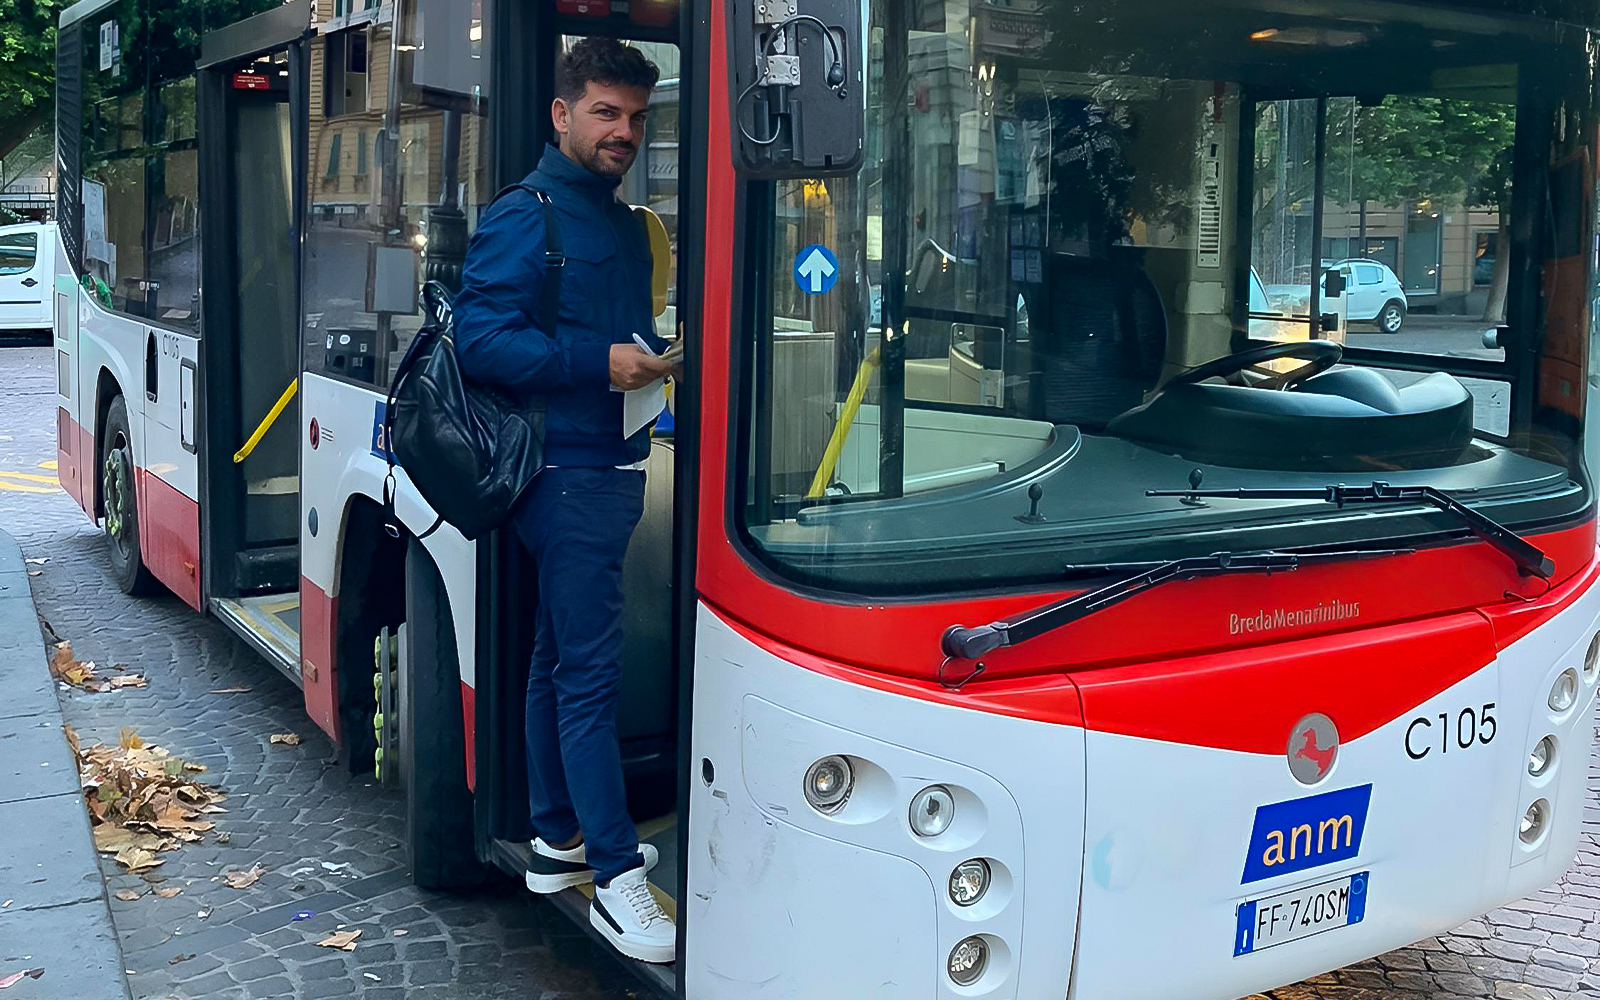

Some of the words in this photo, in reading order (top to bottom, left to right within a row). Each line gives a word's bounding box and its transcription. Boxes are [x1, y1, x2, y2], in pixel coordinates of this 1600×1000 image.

[1229, 598, 1360, 635] BredaMenarinibus
[1404, 702, 1497, 760] C105
[1262, 814, 1353, 867] anm
